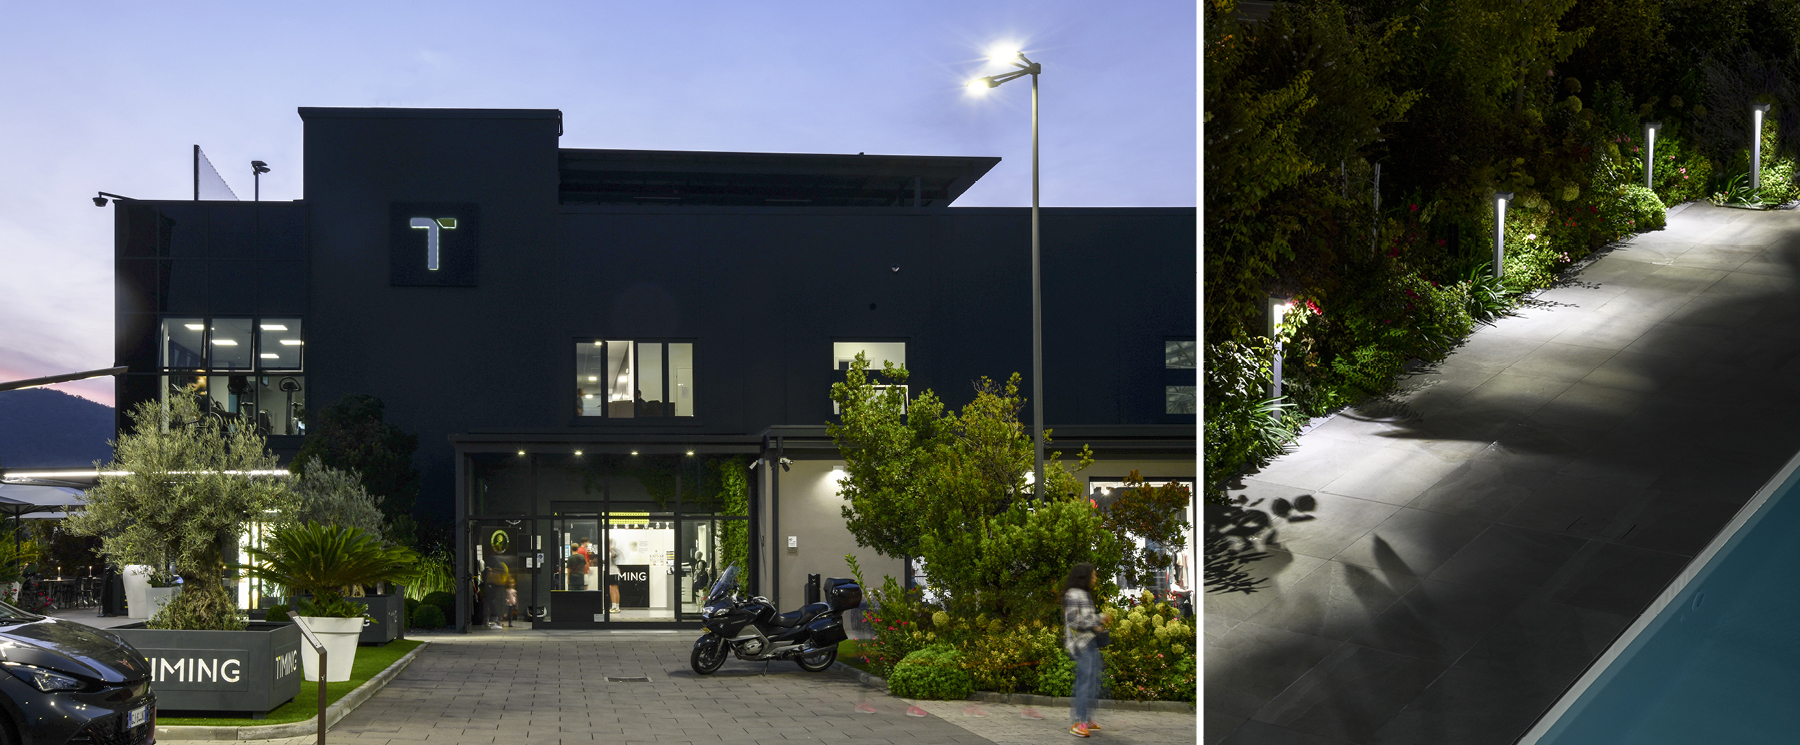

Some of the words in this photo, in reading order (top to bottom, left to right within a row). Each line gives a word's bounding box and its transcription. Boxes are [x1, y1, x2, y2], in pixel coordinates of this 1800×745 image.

[410, 217, 457, 271] T
[616, 571, 647, 581] MING
[144, 657, 241, 683] IMING
[275, 649, 298, 680] TIMING
